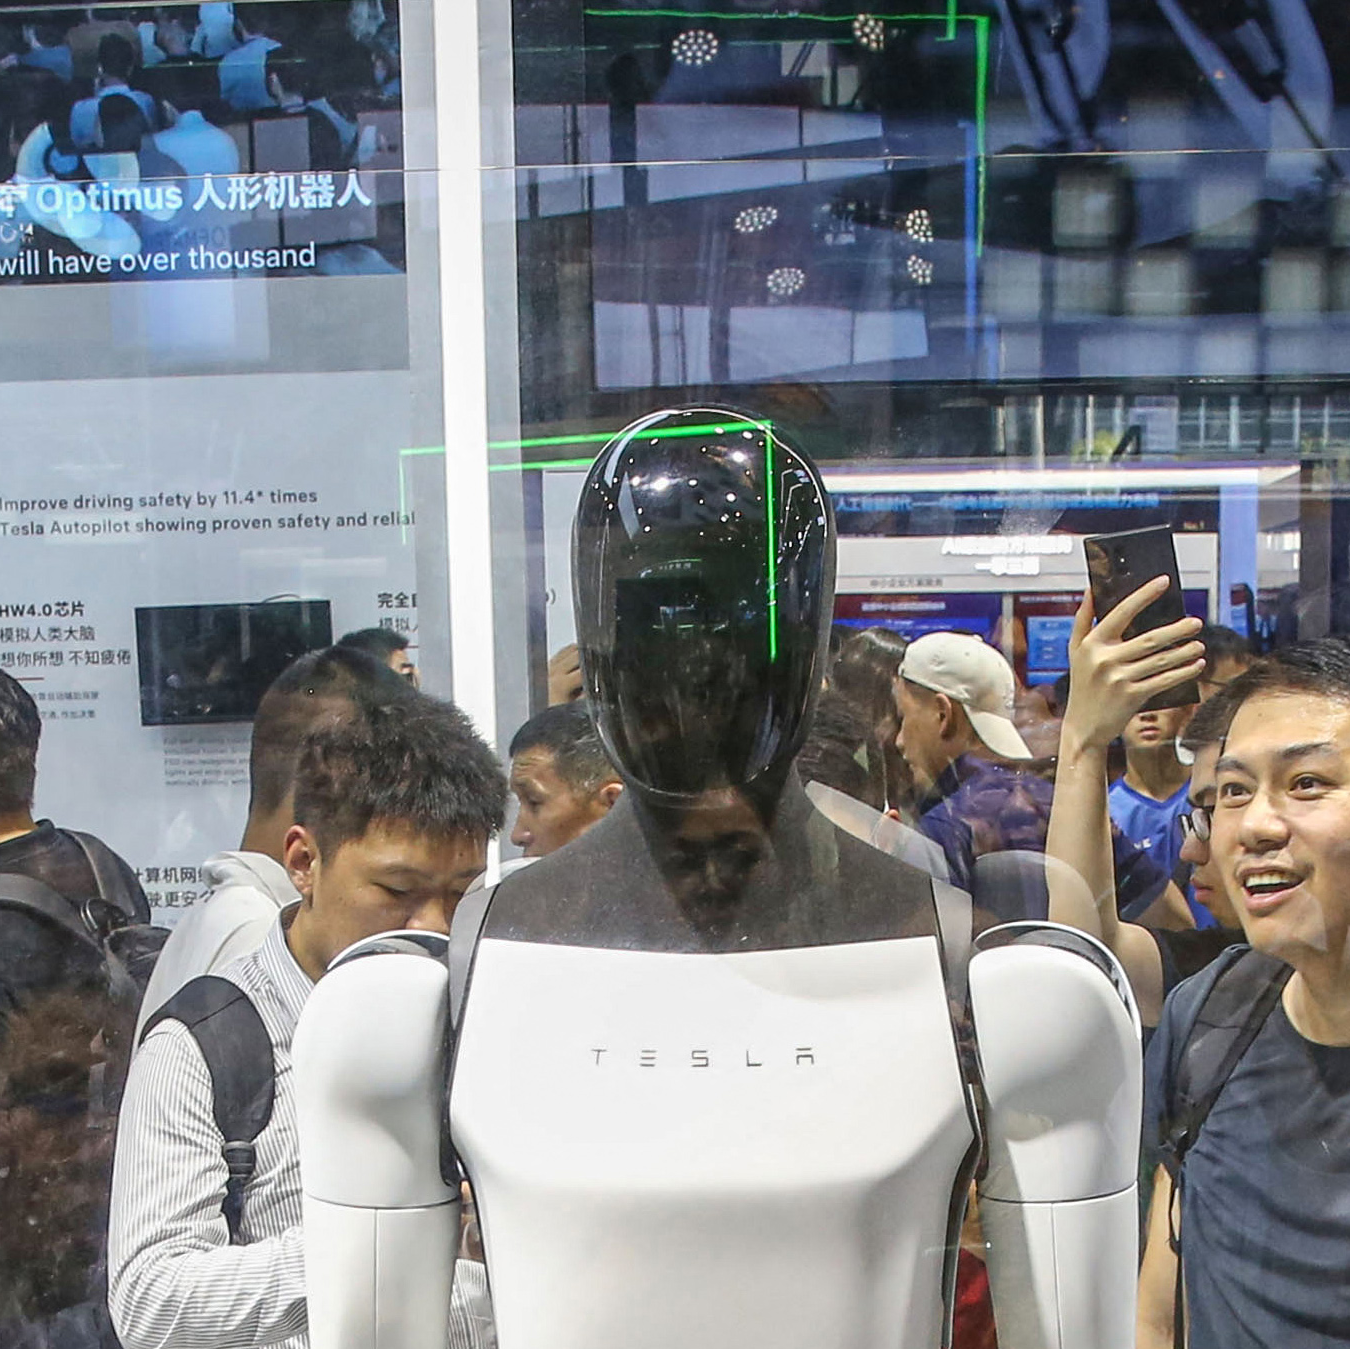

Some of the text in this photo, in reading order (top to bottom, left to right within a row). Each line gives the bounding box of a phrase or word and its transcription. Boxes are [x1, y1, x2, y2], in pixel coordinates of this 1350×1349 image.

[36, 182, 182, 213] Optimus
[194, 169, 371, 211] 人形机器人
[49, 250, 112, 274] have
[120, 252, 179, 271] over
[189, 243, 316, 270] thousand
[73, 493, 133, 512] driving
[138, 491, 192, 509] safety
[196, 491, 217, 508] by
[269, 489, 318, 504] times
[0, 521, 44, 536] Tesla
[50, 518, 131, 537] Autopilot
[136, 517, 207, 535] showing
[212, 516, 272, 532] proven
[278, 512, 331, 531] safety
[336, 511, 368, 527] and
[0, 625, 96, 643] 模拟人类大脑
[1, 651, 63, 668] 想你所想
[591, 1047, 815, 1067] TESLA
